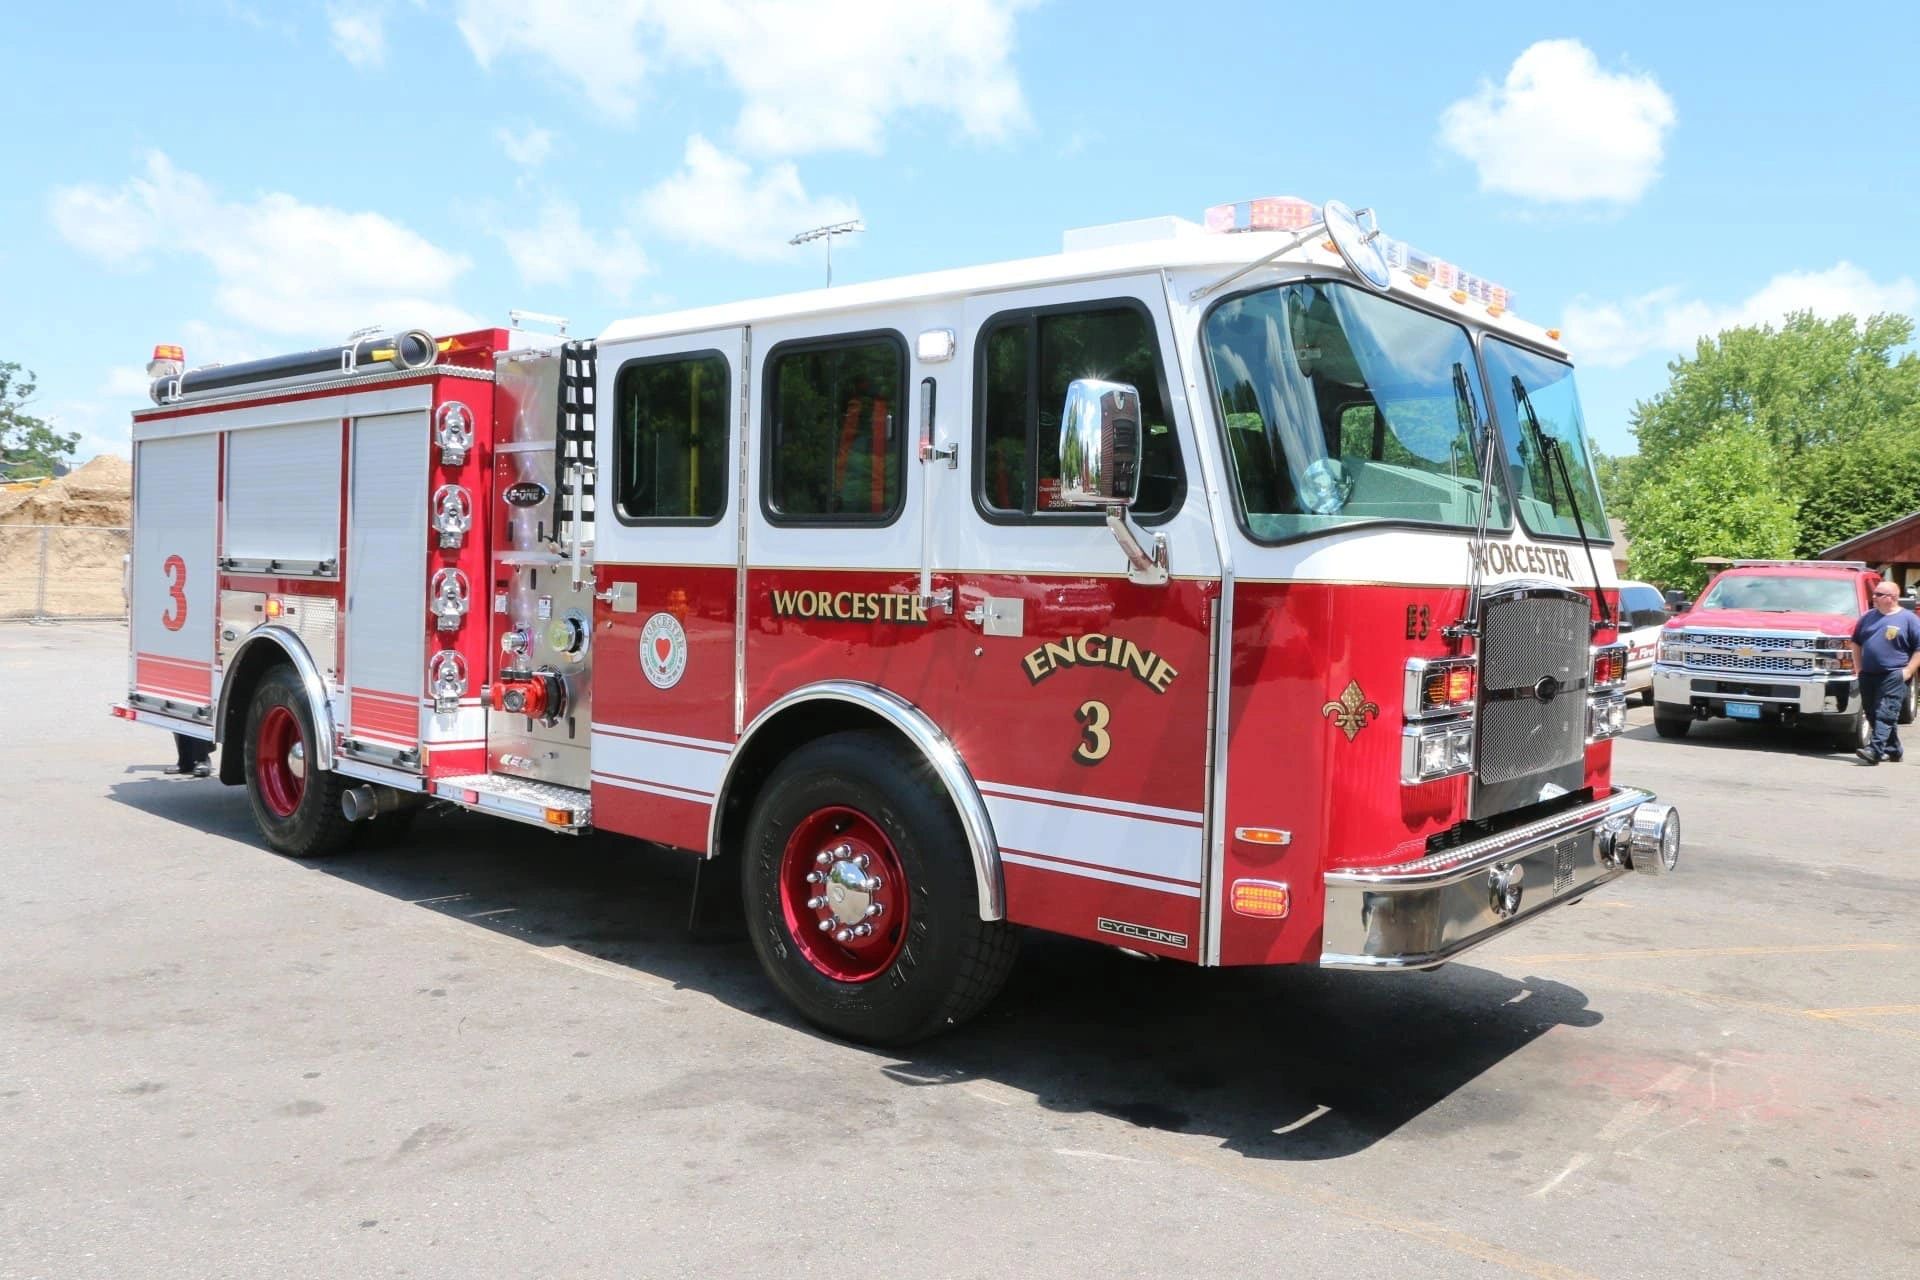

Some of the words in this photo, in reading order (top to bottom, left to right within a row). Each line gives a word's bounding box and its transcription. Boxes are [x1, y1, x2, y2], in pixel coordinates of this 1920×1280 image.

[1467, 541, 1574, 581] WORCESTER
[162, 554, 187, 631] 3
[772, 590, 928, 623] WORCESTER
[1407, 605, 1429, 640] E3
[1022, 633, 1178, 693] ENGINE
[1074, 700, 1111, 763] 3
[1100, 921, 1185, 945] CYCLONE
